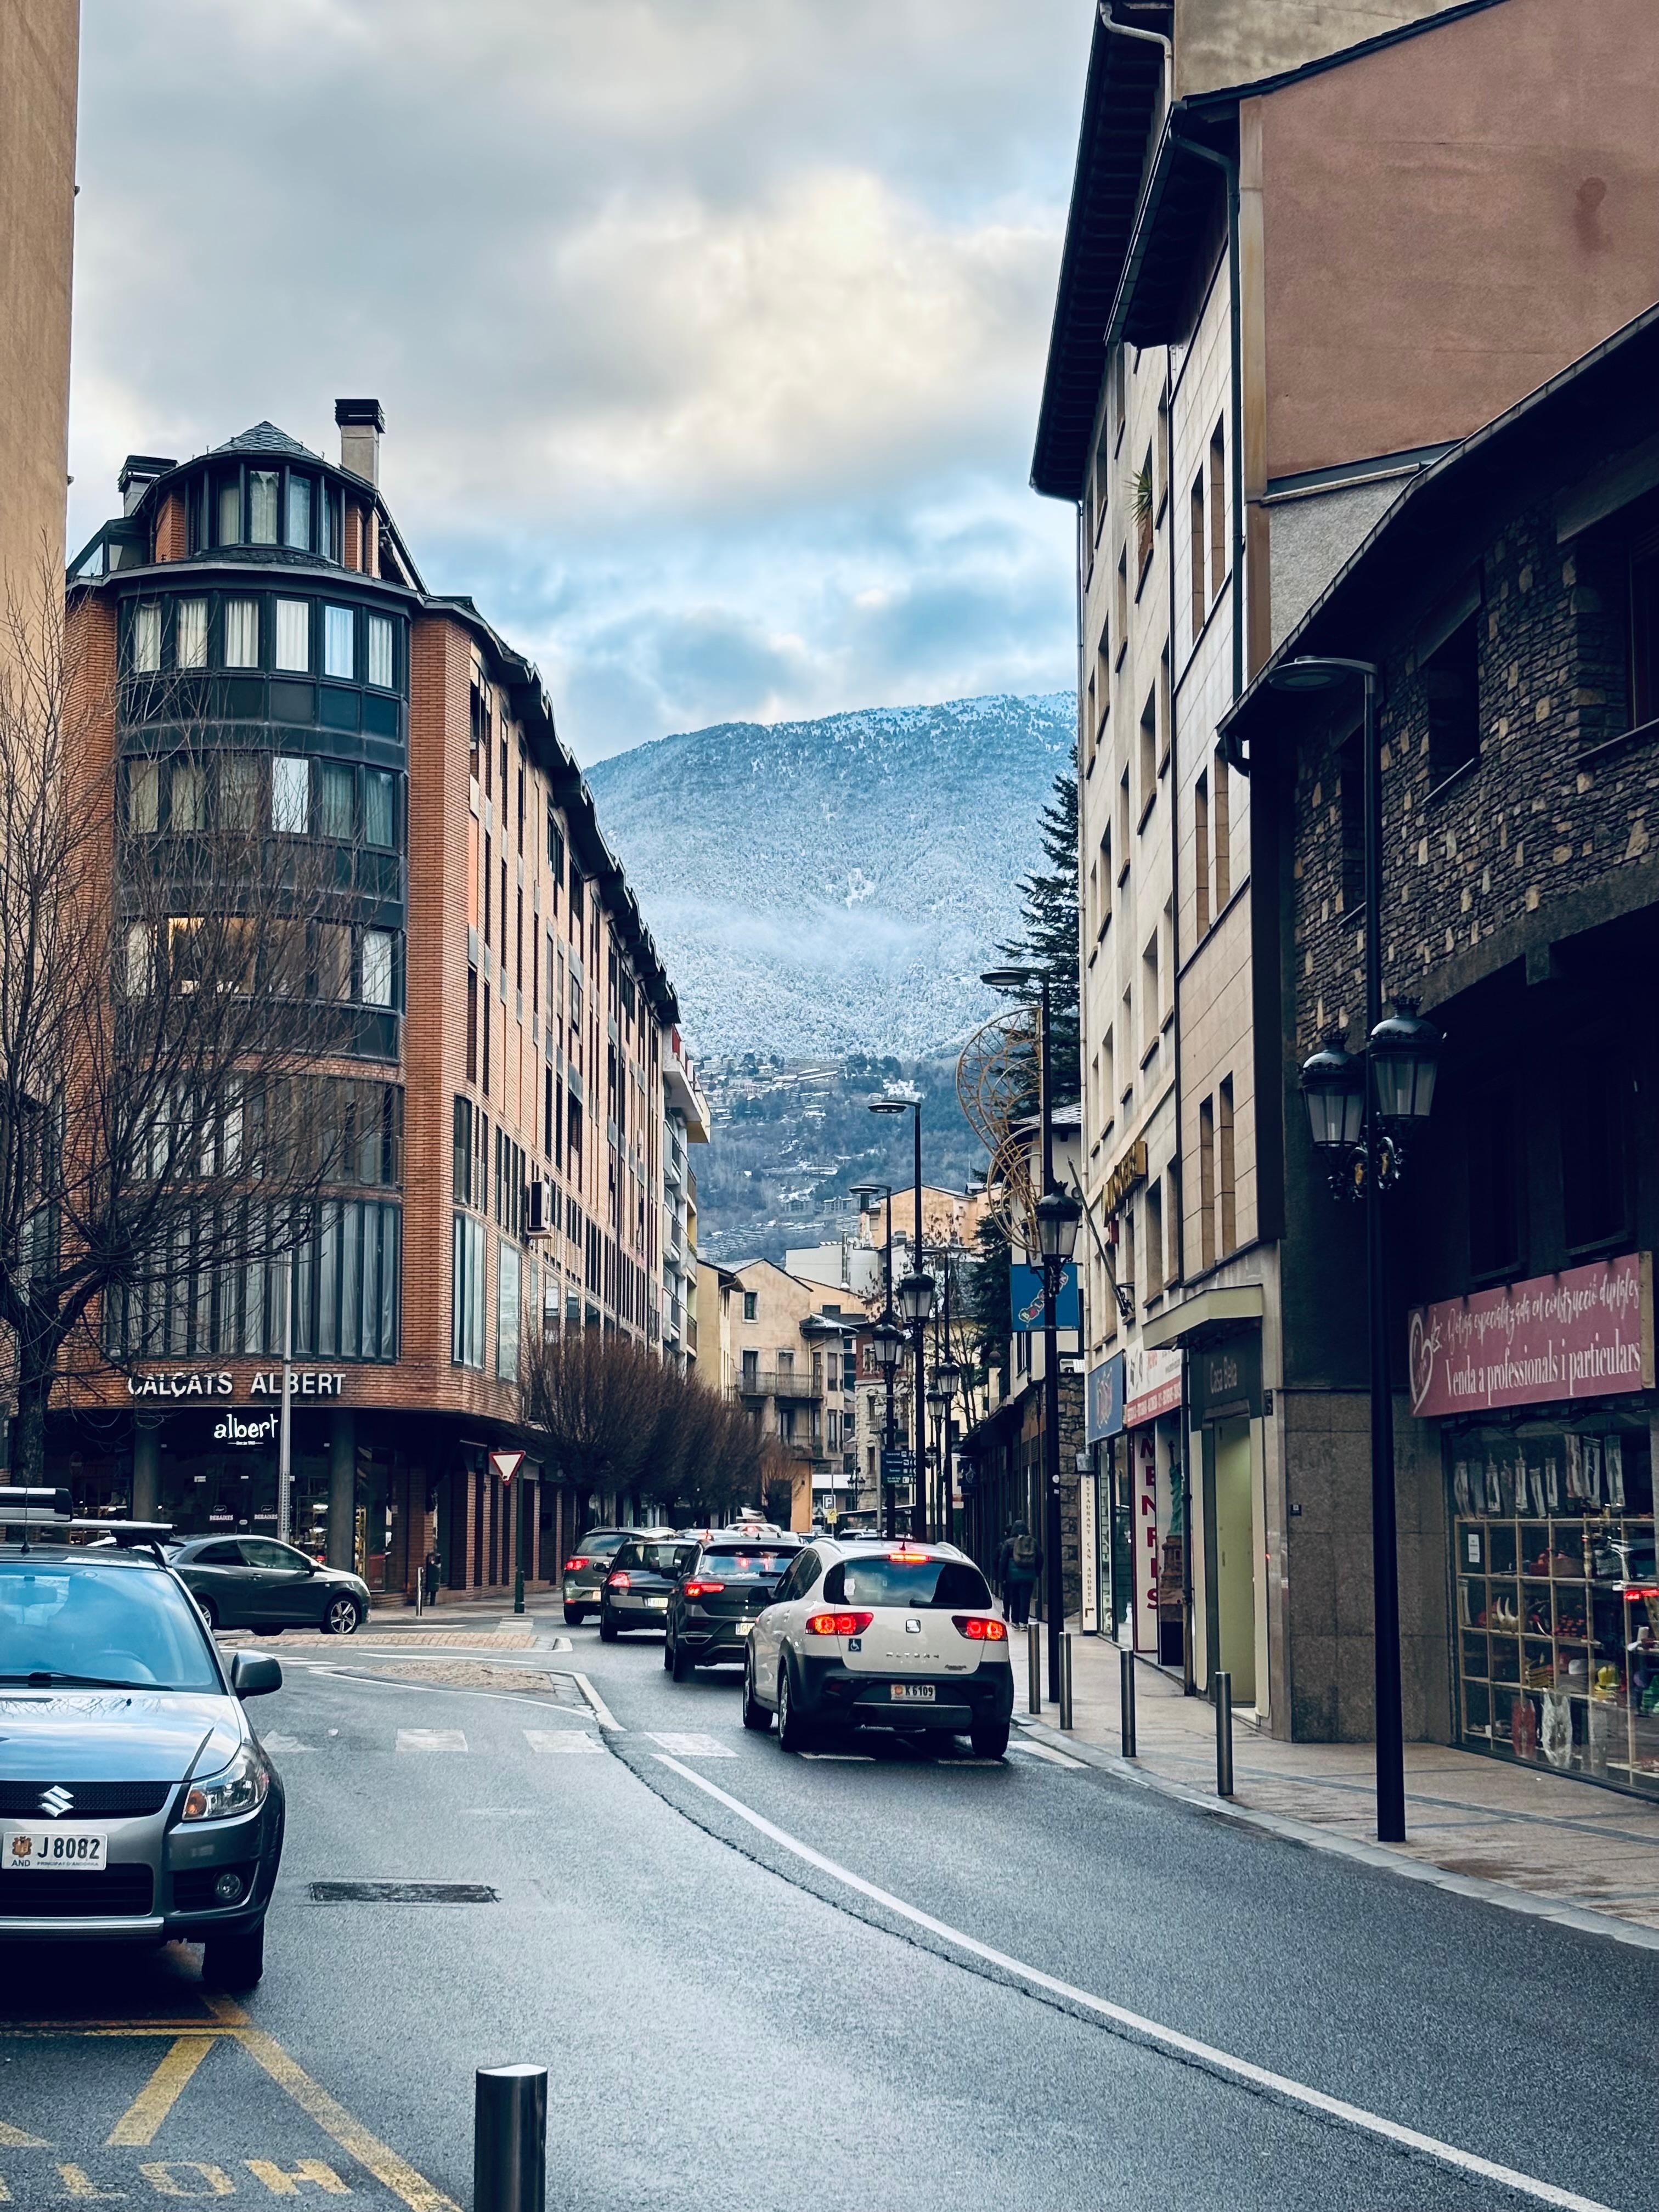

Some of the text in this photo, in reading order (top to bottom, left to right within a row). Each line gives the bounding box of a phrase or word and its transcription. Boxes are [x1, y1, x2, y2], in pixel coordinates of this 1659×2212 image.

[1445, 1355, 1477, 1397] Venda
[1479, 1368, 1485, 1393] a
[1487, 1340, 1558, 1406] professionals
[1561, 1338, 1567, 1380] i
[1568, 1328, 1641, 1396] particulars
[128, 1372, 346, 1397] CALÇATS ALBERT
[213, 1413, 279, 1439] albert
[912, 1685, 933, 1696] 6109
[37, 1837, 100, 1859] J 8082
[0, 2158, 354, 2201] HOT
